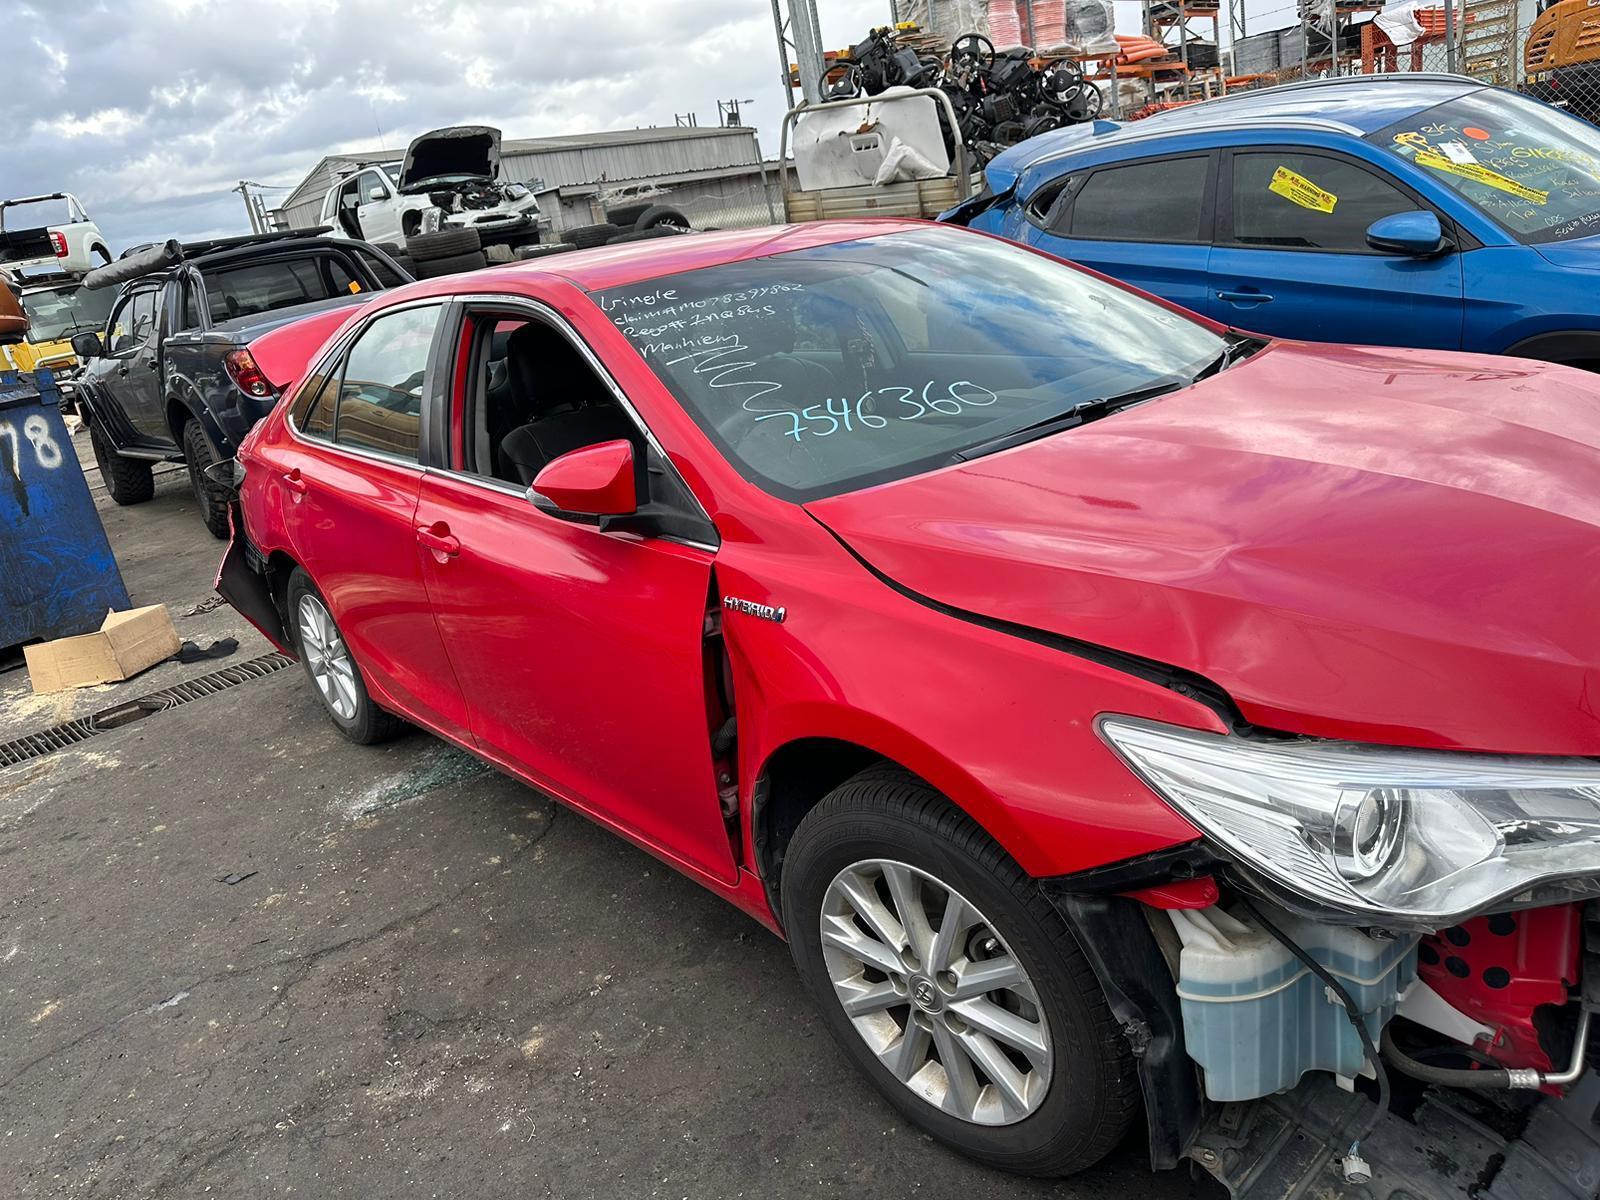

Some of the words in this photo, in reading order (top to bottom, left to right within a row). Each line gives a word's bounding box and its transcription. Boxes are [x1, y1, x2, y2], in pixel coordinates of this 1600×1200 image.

[755, 380, 998, 442] 7546360
[0, 413, 64, 481] 78
[723, 595, 775, 620] HYBRID
